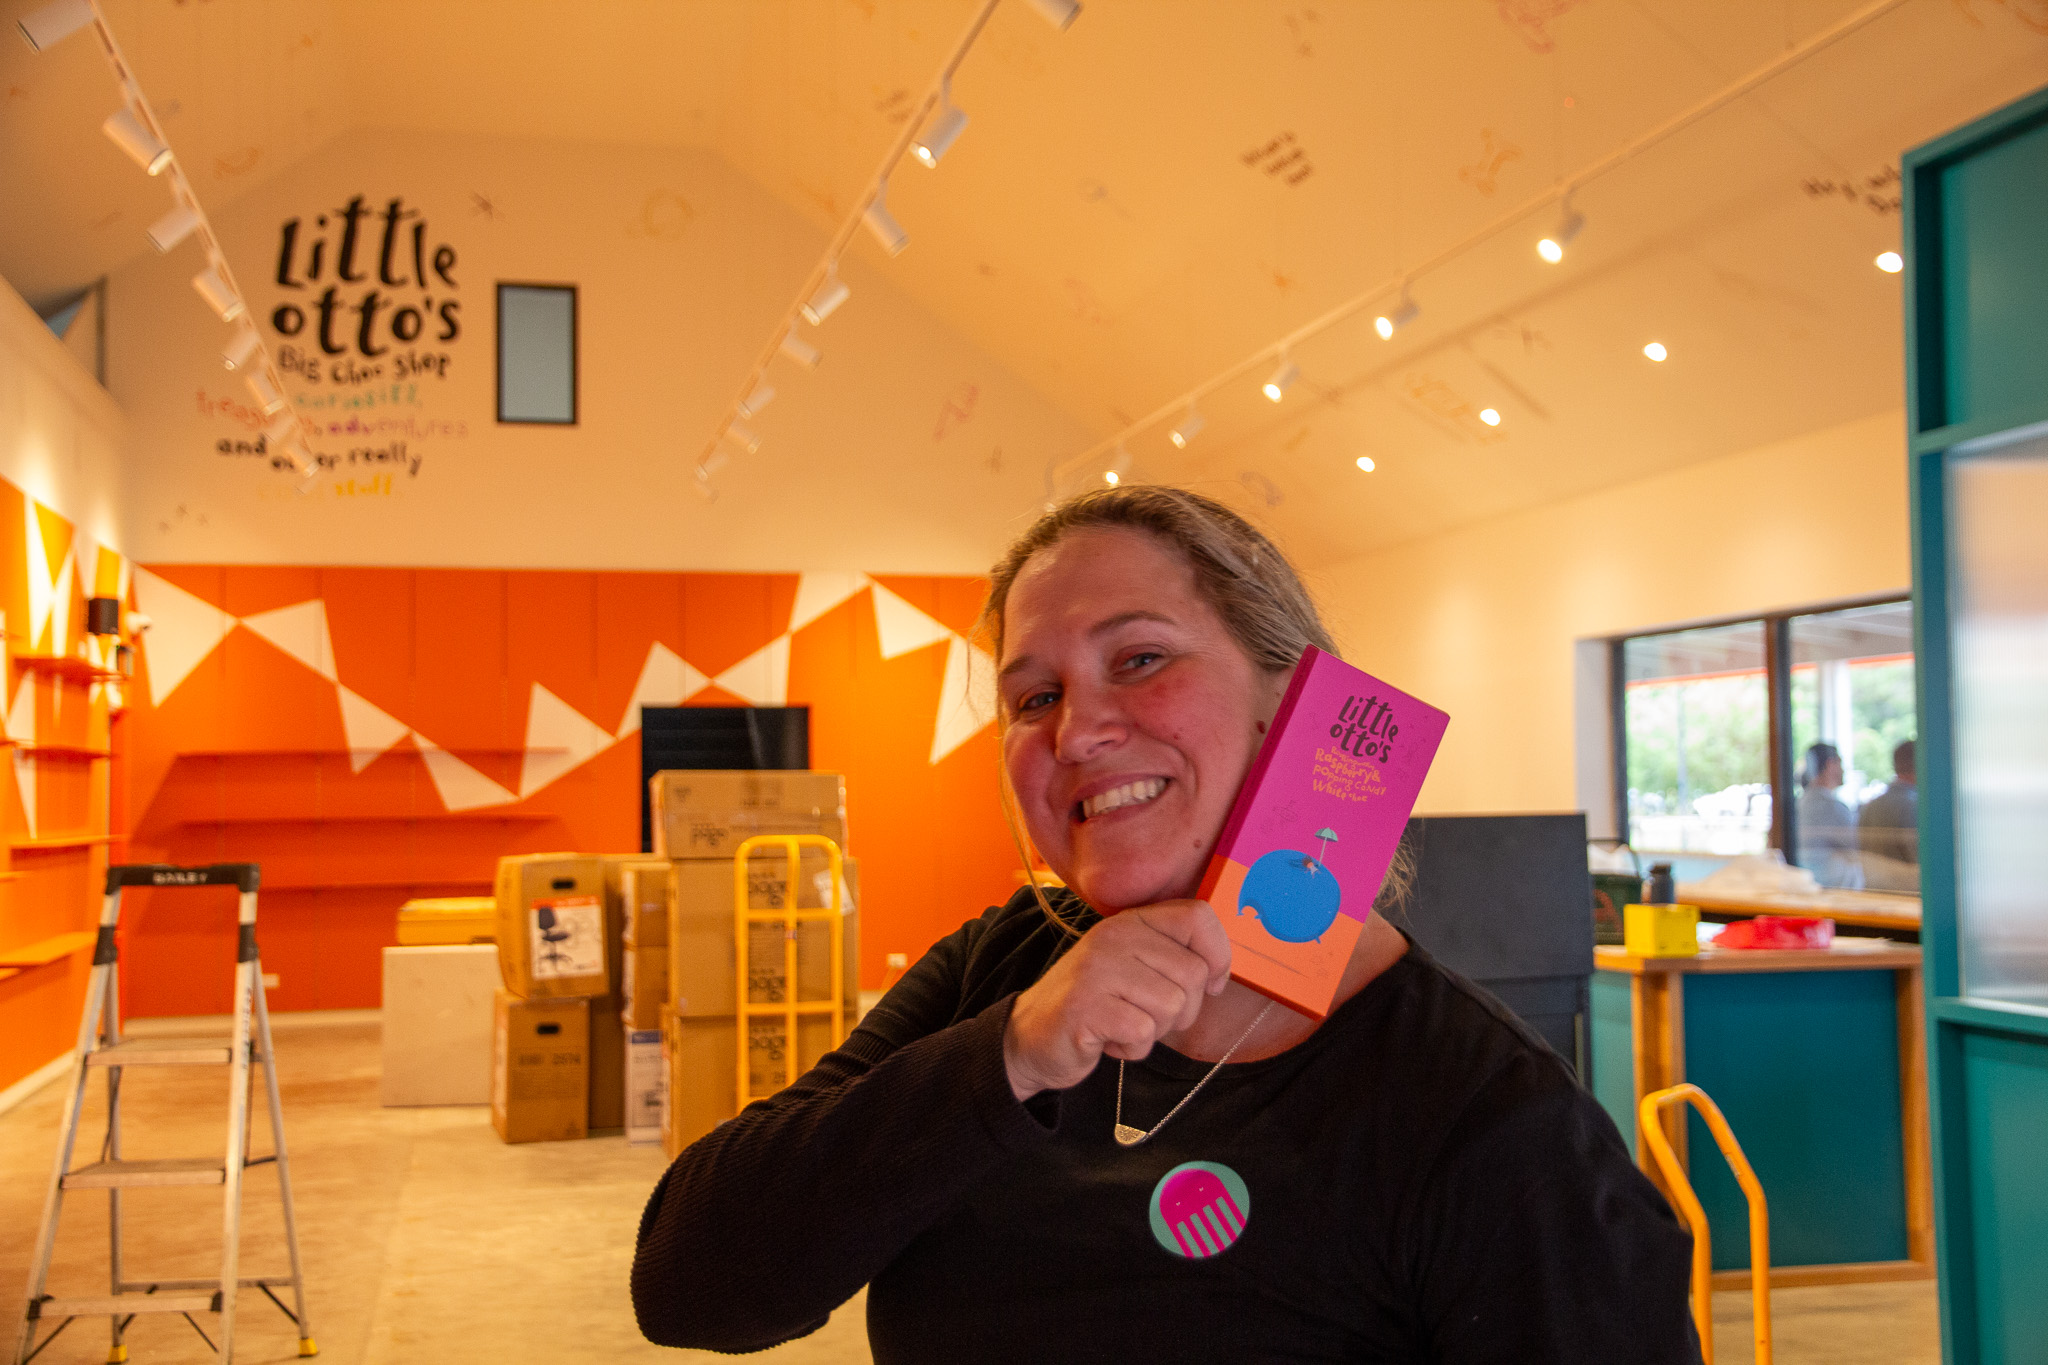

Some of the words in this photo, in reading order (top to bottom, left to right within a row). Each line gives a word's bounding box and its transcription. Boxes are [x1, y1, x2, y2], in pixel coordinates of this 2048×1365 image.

[275, 193, 459, 289] Little
[271, 286, 461, 357] otto's
[215, 431, 268, 457] and
[348, 440, 422, 478] really
[1337, 695, 1399, 743] Little
[1315, 748, 1373, 784] Raspberry
[1329, 723, 1392, 764] otto's
[1312, 778, 1347, 801] White
